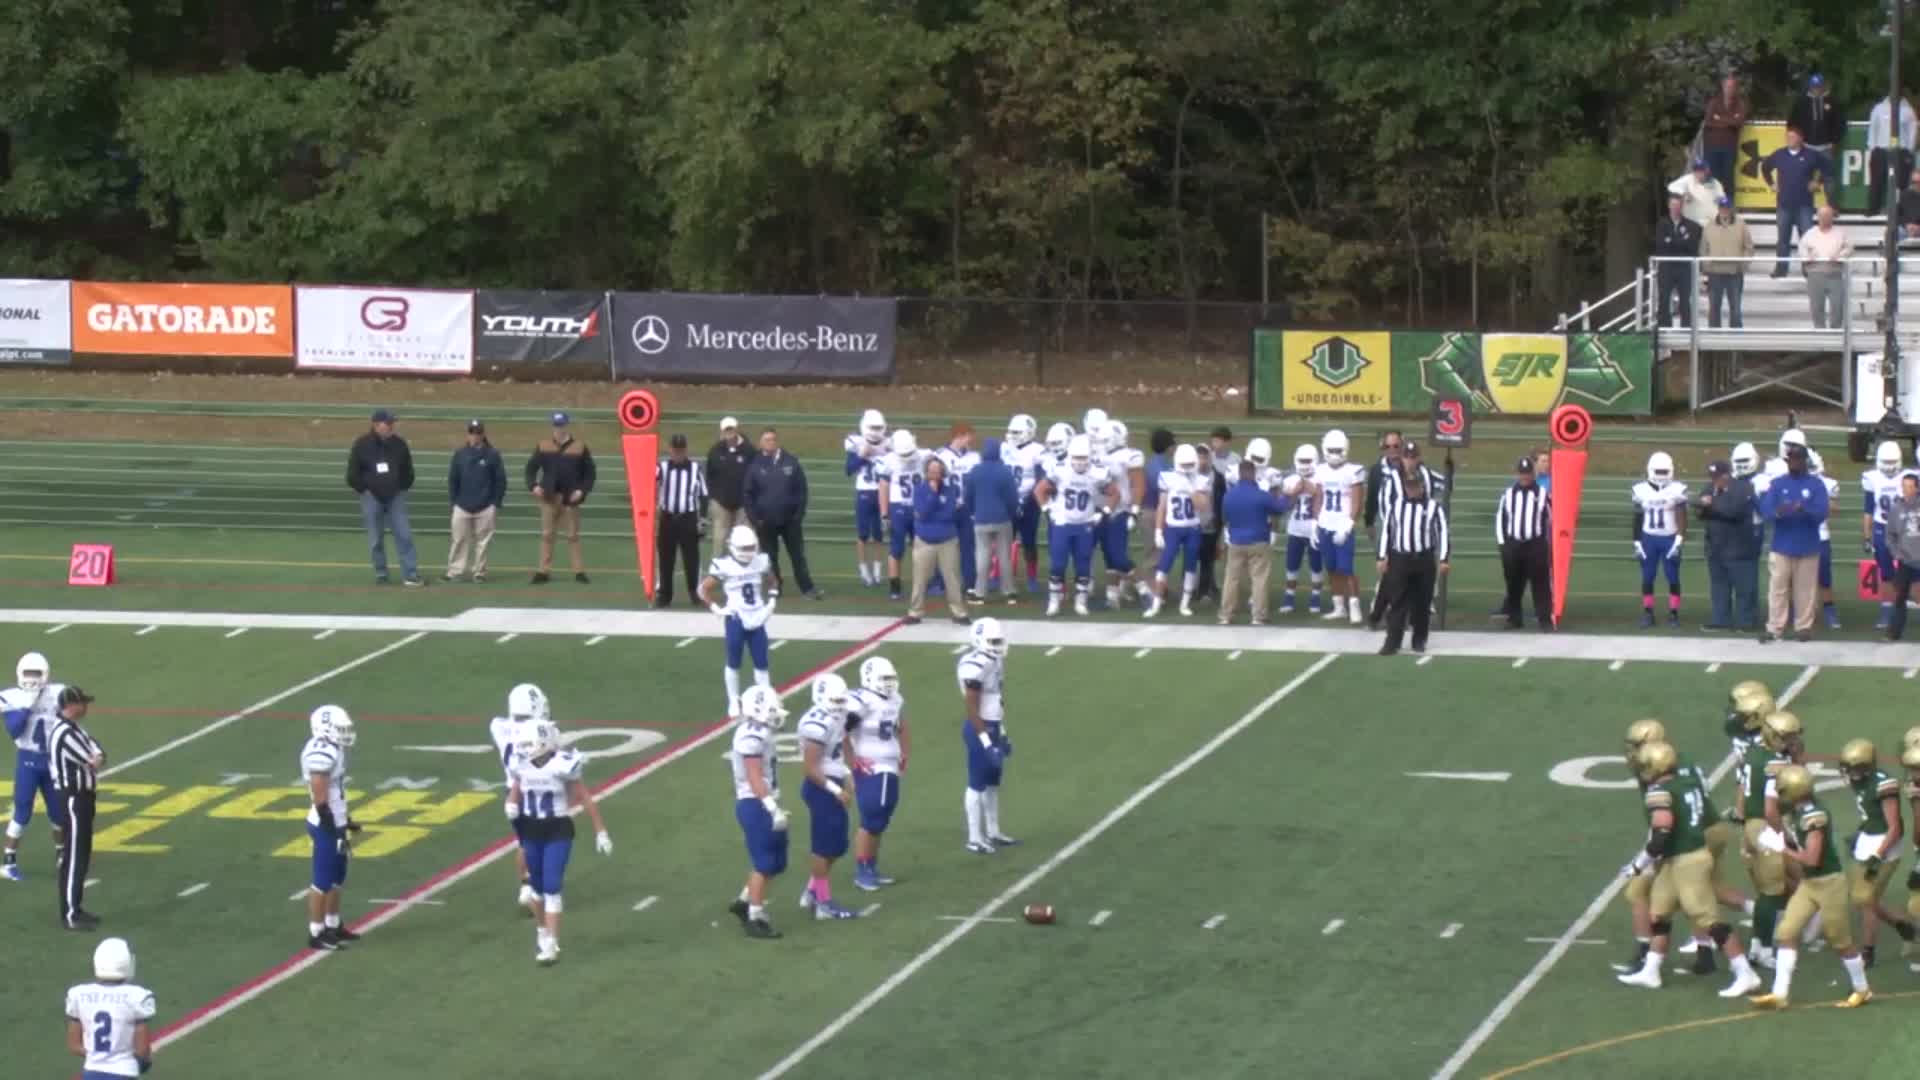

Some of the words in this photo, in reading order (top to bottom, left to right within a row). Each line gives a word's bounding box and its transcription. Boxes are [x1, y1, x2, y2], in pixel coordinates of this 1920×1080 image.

[87, 303, 277, 335] GATORADE
[687, 324, 879, 352] Mercedes-Benz
[1492, 353, 1560, 386] SJR
[1436, 400, 1464, 434] 3
[1064, 490, 1090, 512] 50
[1171, 496, 1195, 520] 20
[1649, 507, 1666, 529] 11
[71, 551, 106, 579] 20
[742, 583, 755, 605] 9
[94, 1010, 112, 1052] 2
